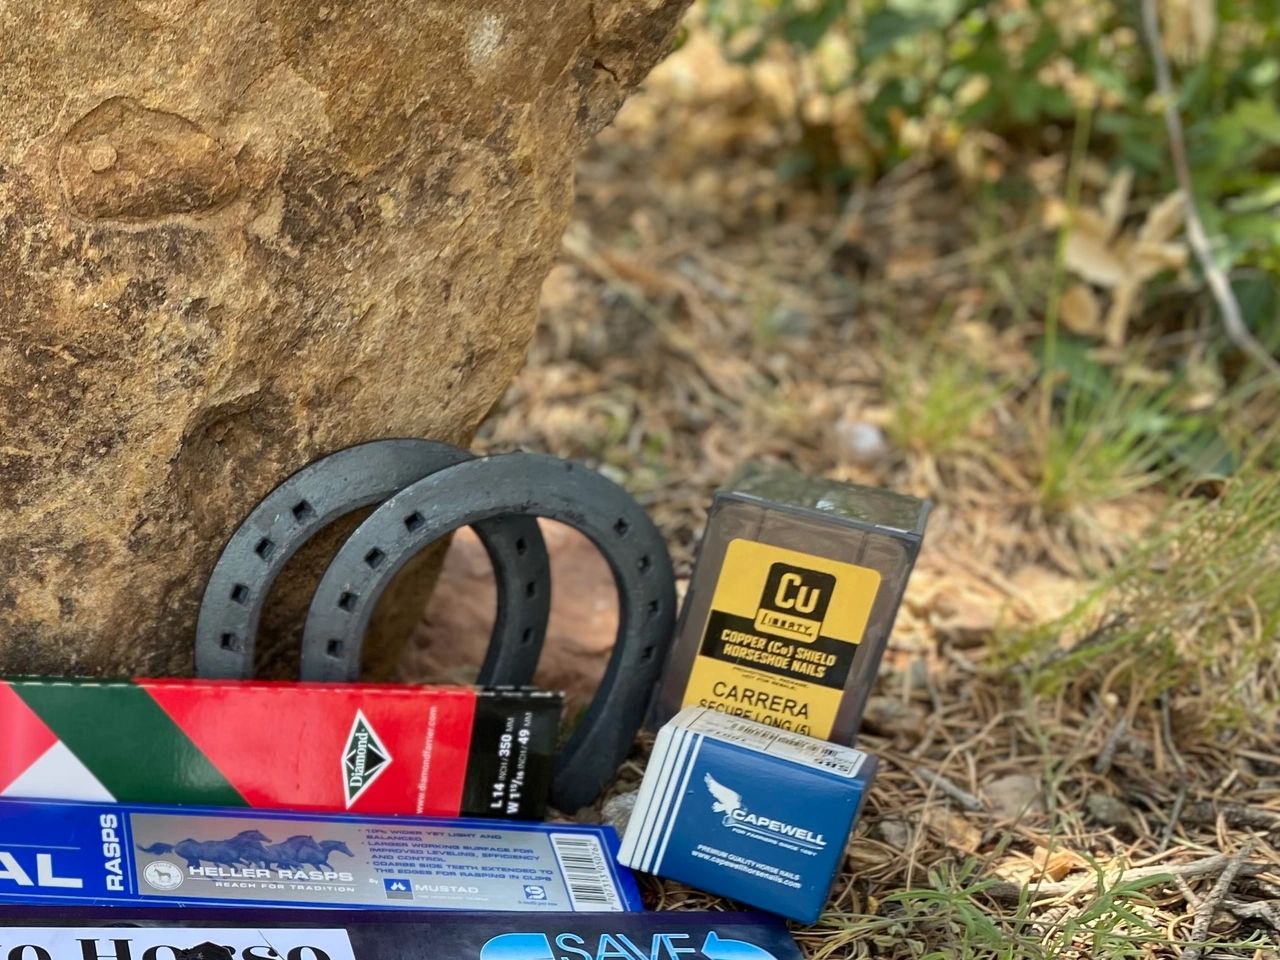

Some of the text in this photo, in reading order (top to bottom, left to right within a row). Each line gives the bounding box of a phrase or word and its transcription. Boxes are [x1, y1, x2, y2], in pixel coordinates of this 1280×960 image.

[774, 572, 821, 614] Cu
[721, 629, 766, 650] COPPER
[794, 647, 836, 667] SHIELD
[723, 643, 827, 678] HORSESHOE NAILS
[712, 681, 809, 719] CARRERA
[506, 717, 514, 732] MM
[349, 732, 368, 787] Diamond
[498, 734, 513, 757] 350
[506, 801, 519, 814] W
[518, 729, 530, 745] 49
[524, 712, 533, 727] MM
[490, 800, 502, 808] L
[492, 783, 505, 797] 14
[732, 809, 827, 846] CAPEWELL
[100, 813, 124, 892] RASPS
[482, 866, 537, 874] EXTENDED
[691, 850, 802, 889] www.capewellhorsenails.com
[697, 844, 801, 881] PREMIUM QUALITY HORSE NAILS
[189, 866, 354, 882] HELLER RASPS
[215, 881, 256, 889] REACH
[291, 884, 355, 892] TRADITION
[415, 884, 479, 894] MUSTAD
